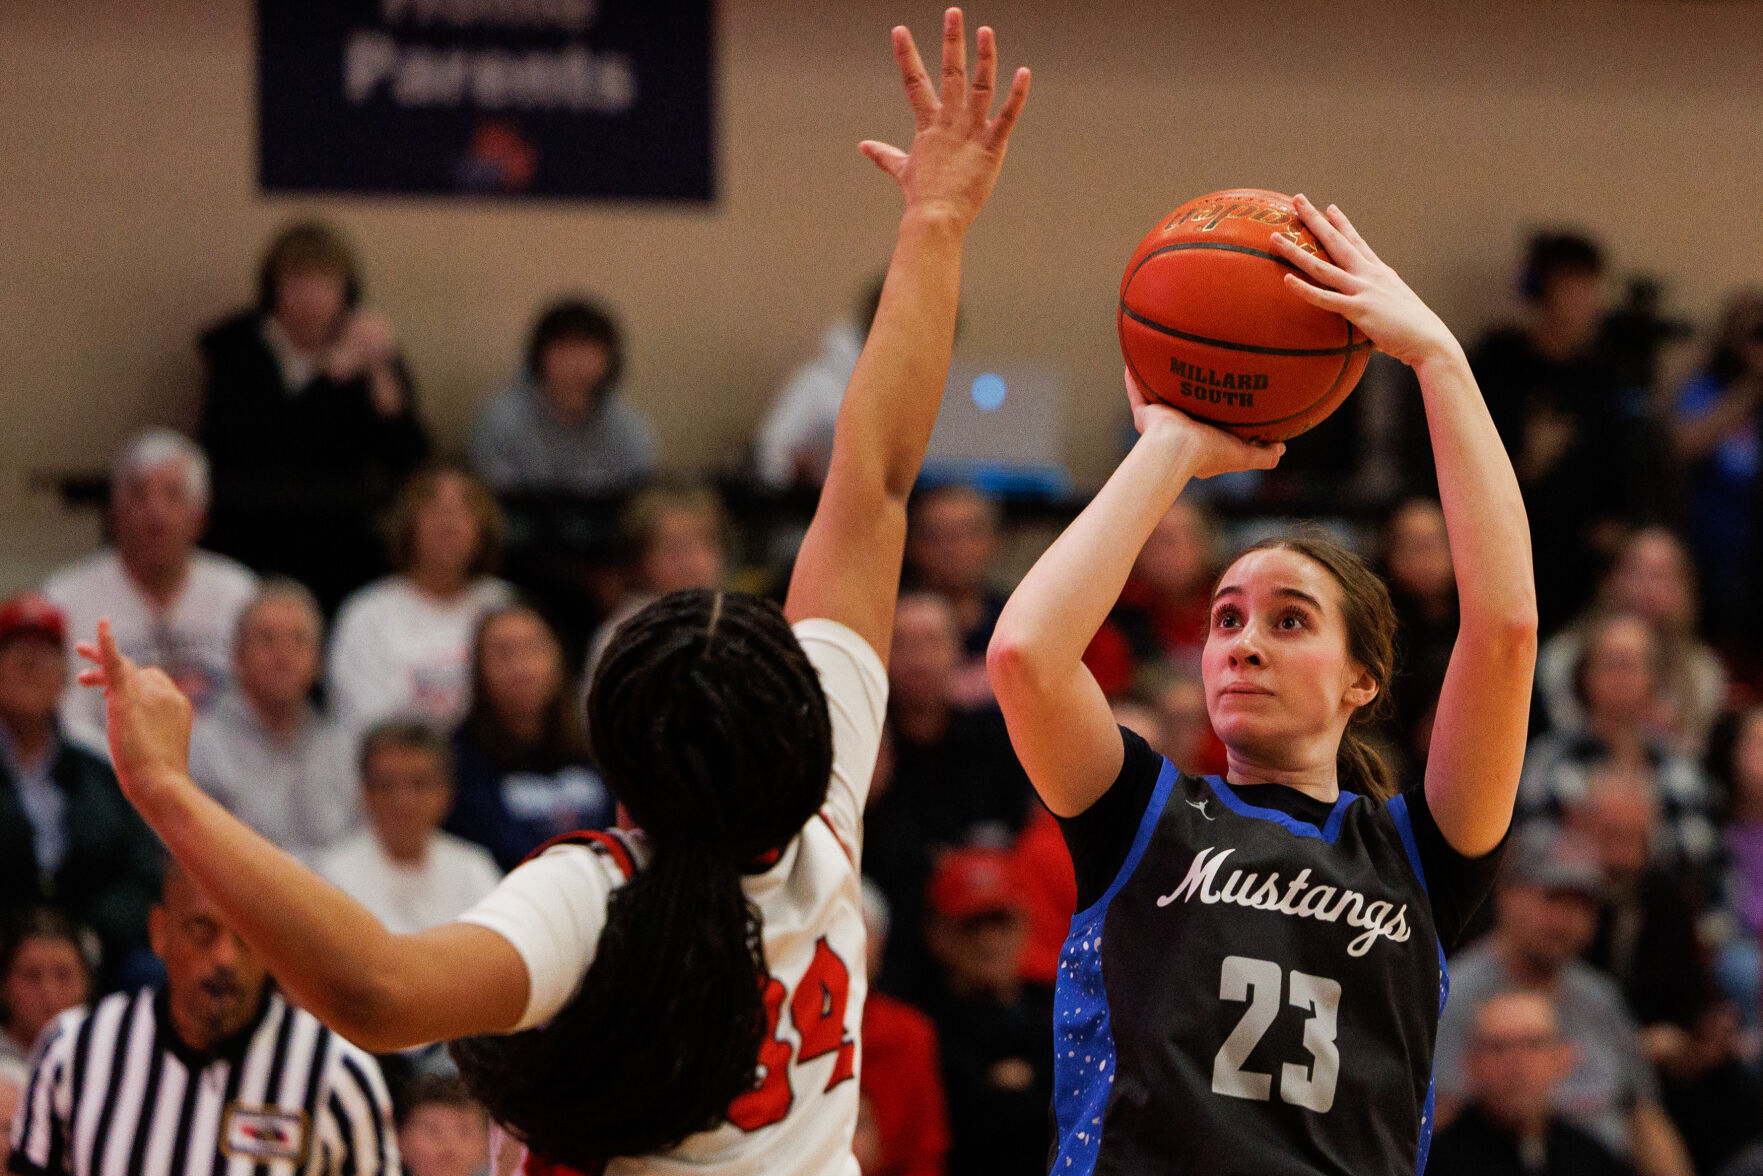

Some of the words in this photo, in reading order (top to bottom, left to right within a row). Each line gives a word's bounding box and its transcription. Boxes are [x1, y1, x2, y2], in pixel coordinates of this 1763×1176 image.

[1170, 357, 1269, 390] MILLARD
[1180, 381, 1254, 407] SOUTH
[1157, 847, 1411, 957] Mustangs
[1212, 956, 1341, 1113] 23
